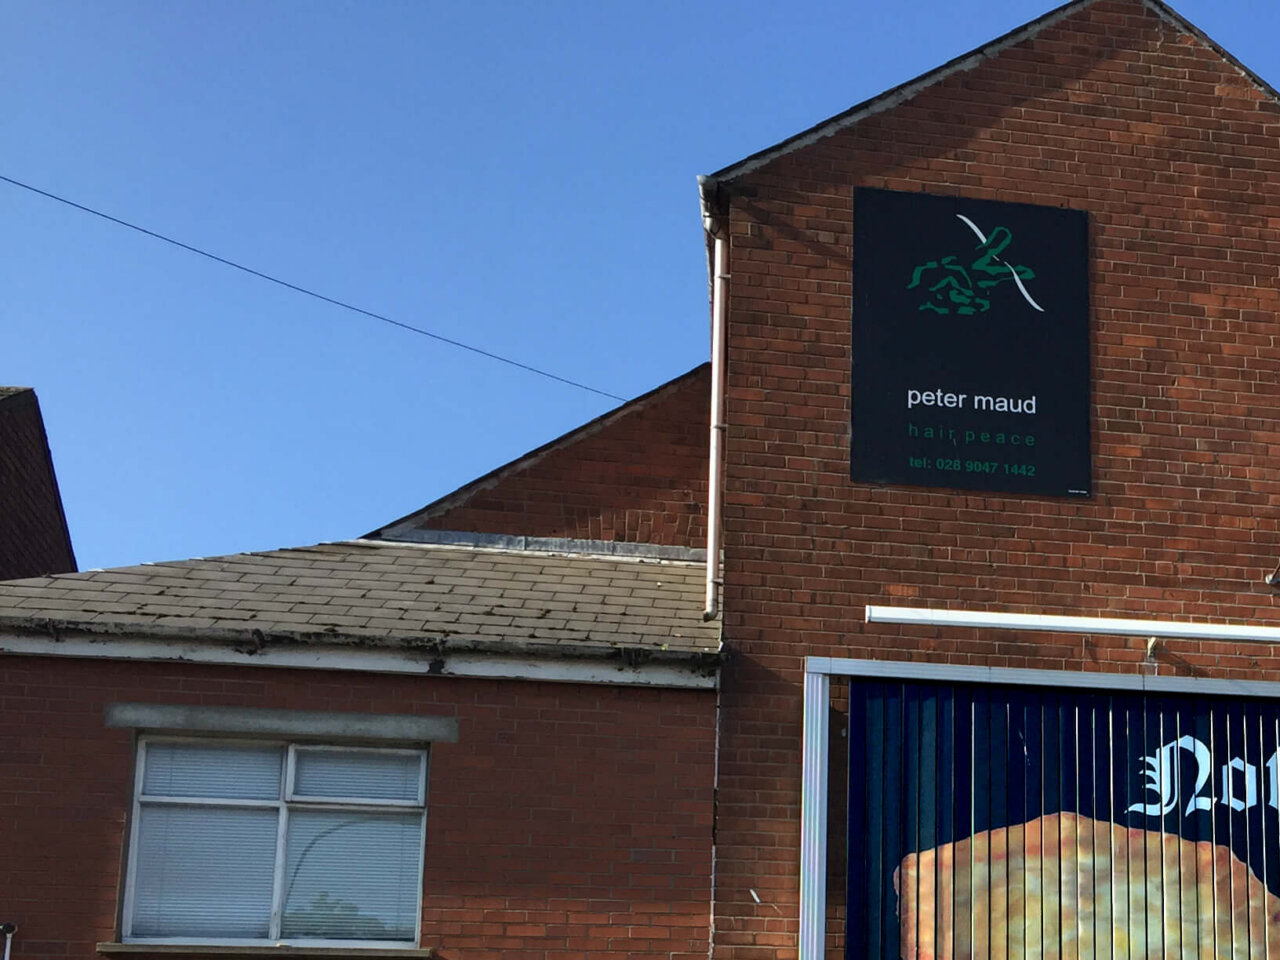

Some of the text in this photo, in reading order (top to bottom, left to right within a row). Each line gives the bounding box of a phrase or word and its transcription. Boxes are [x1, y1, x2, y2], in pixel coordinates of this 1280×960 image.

[907, 388, 1036, 414] peter maud
[908, 423, 1035, 446] hair peace
[909, 456, 1036, 477] tel: 028 9047 1442
